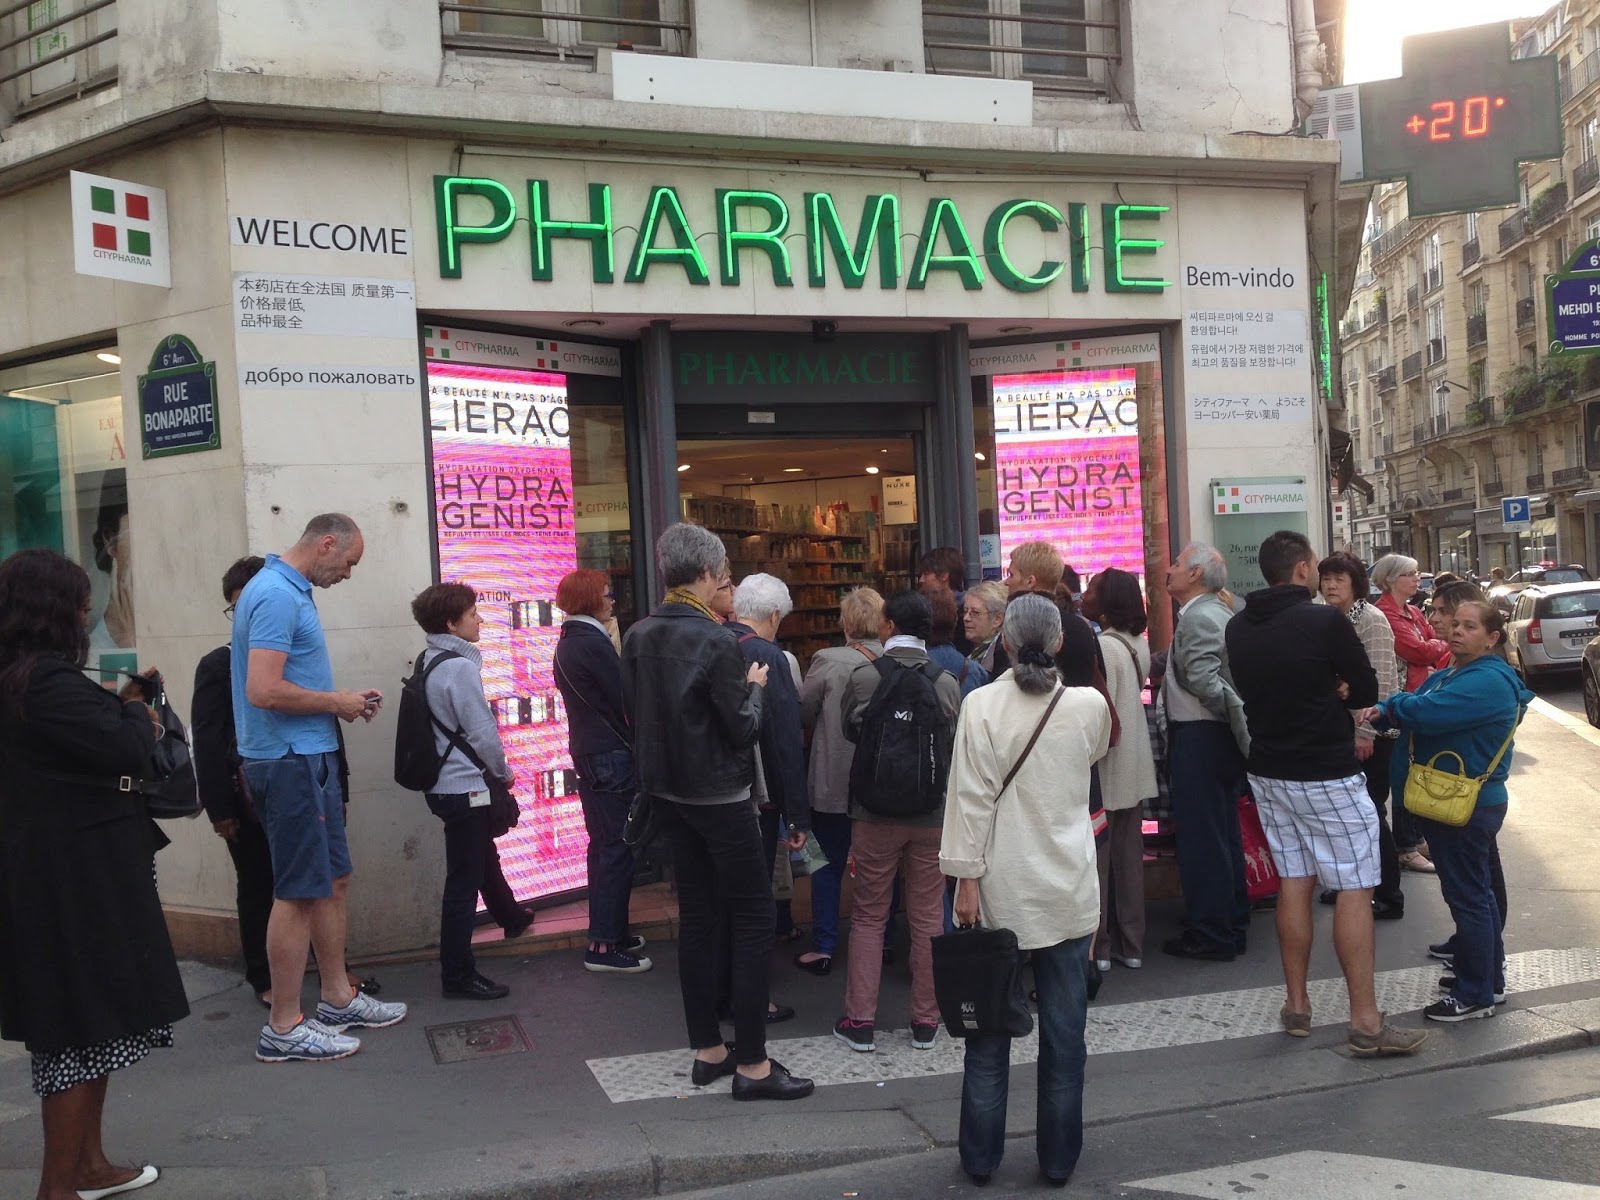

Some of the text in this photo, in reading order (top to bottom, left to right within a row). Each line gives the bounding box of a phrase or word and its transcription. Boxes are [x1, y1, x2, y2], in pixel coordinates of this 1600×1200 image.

[237, 217, 408, 256] WELCOME
[433, 174, 1173, 294] PHARMACIE
[93, 249, 152, 267] CITYPHARMA
[1590, 254, 1600, 267] 6
[1187, 266, 1295, 288] Bem-vindo
[239, 278, 346, 297] 本药店在全法国
[1190, 311, 1244, 322] 씨티파르마에
[1246, 312, 1263, 322] 오신
[1559, 303, 1593, 316] MEHDI
[241, 313, 303, 329] 品种最全
[1190, 325, 1238, 336] 환영합니다!
[1565, 333, 1588, 341] HOMME
[455, 340, 520, 357] CITYPHARMA
[1087, 342, 1157, 358] CITYPHARMA
[1191, 343, 1304, 355] 유럽에서 가장 저렴한 가격에
[563, 352, 620, 368] CITYPHARMA
[969, 353, 1037, 368] CITYPHARMA
[1191, 357, 1296, 368] 최고의 품질을 보장합니다!
[680, 352, 922, 385] PHARMACIE
[245, 367, 415, 387] добро пожаловать
[163, 381, 189, 404] RUE
[444, 387, 487, 399] BEAUTÉ
[492, 391, 511, 400] N'A
[515, 392, 535, 402] PAS
[1008, 391, 1051, 403] BEAUTÉ
[1057, 391, 1075, 400] N'A
[1080, 389, 1100, 398] PAS
[1194, 397, 1249, 408] シティファーマ
[1275, 397, 1306, 407] ようこそ
[144, 403, 214, 432] BONAPARTE
[1085, 425, 1138, 434] PARI
[522, 437, 570, 447] PARI
[1003, 462, 1135, 490] HYDRA
[440, 473, 568, 502] HYDRA
[1003, 486, 1134, 514] GENIST
[1244, 493, 1304, 504] CITYPHARMA
[586, 501, 629, 513] CITYPHA
[1510, 503, 1522, 518] P
[441, 501, 568, 529] GENIST
[1230, 544, 1243, 553] 26,
